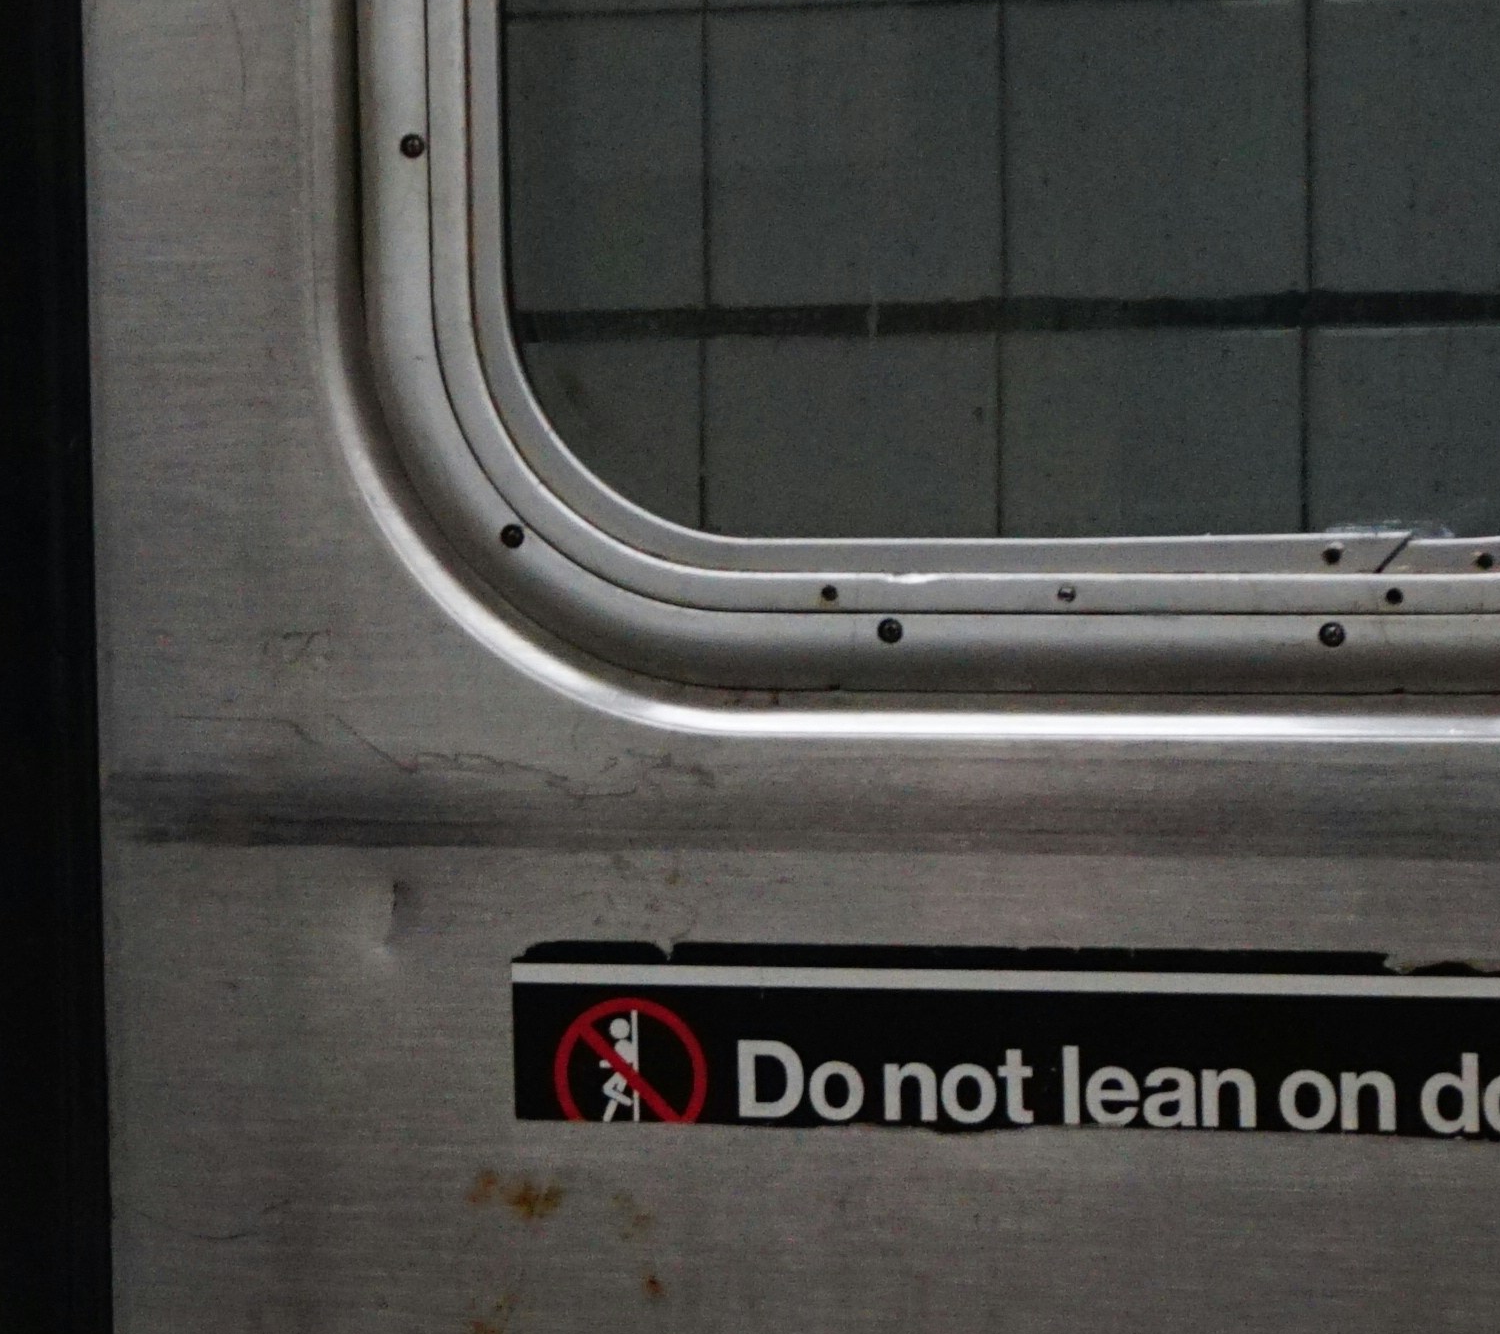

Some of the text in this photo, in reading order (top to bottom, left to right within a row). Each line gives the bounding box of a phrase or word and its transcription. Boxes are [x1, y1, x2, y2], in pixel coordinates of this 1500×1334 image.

[737, 1039, 865, 1121] Do
[883, 1048, 1034, 1125] not
[1061, 1044, 1257, 1129] lean
[1278, 1069, 1397, 1132] on
